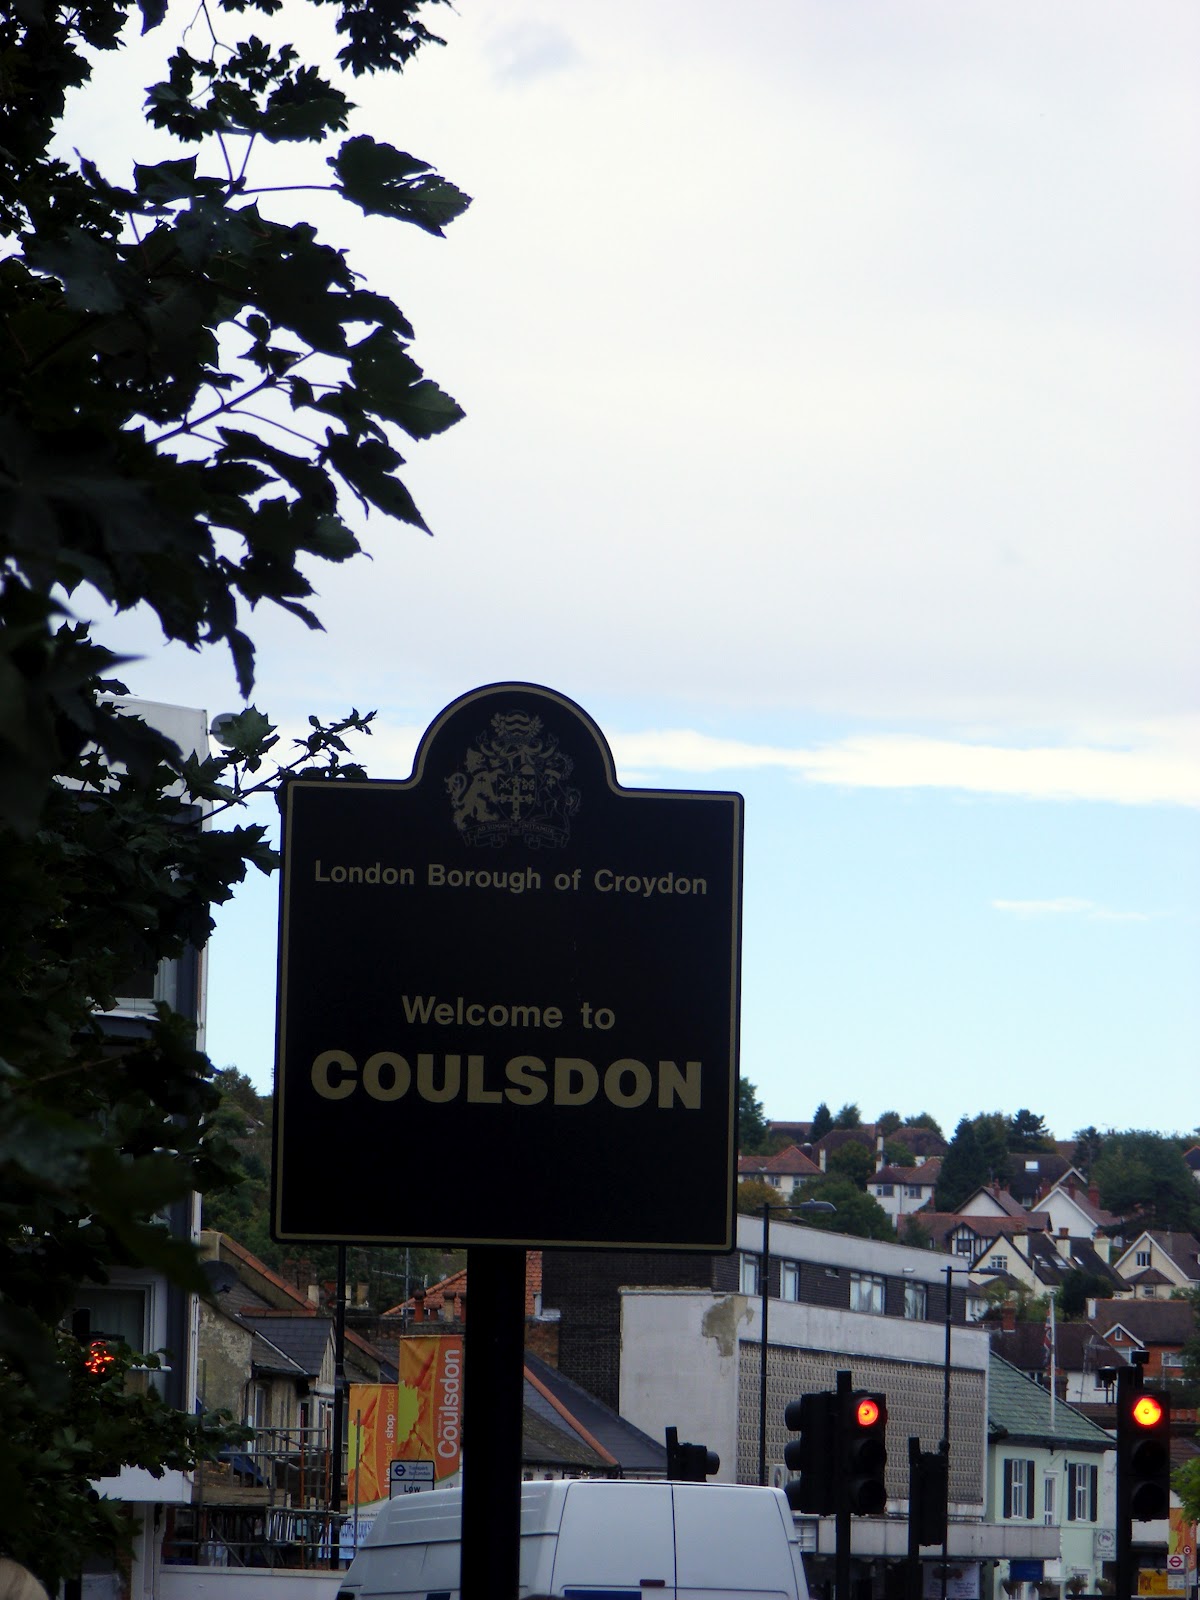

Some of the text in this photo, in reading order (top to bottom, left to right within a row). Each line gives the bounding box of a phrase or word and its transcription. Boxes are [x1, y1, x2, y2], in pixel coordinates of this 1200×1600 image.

[315, 859, 707, 898] London Borough of Croydon
[402, 995, 616, 1030] Welcome to
[311, 1049, 702, 1110] COULSDON
[386, 1389, 395, 1413] local
[437, 1349, 460, 1459] Coulsdon
[386, 1414, 396, 1438] shop
[403, 1484, 421, 1493] Low
